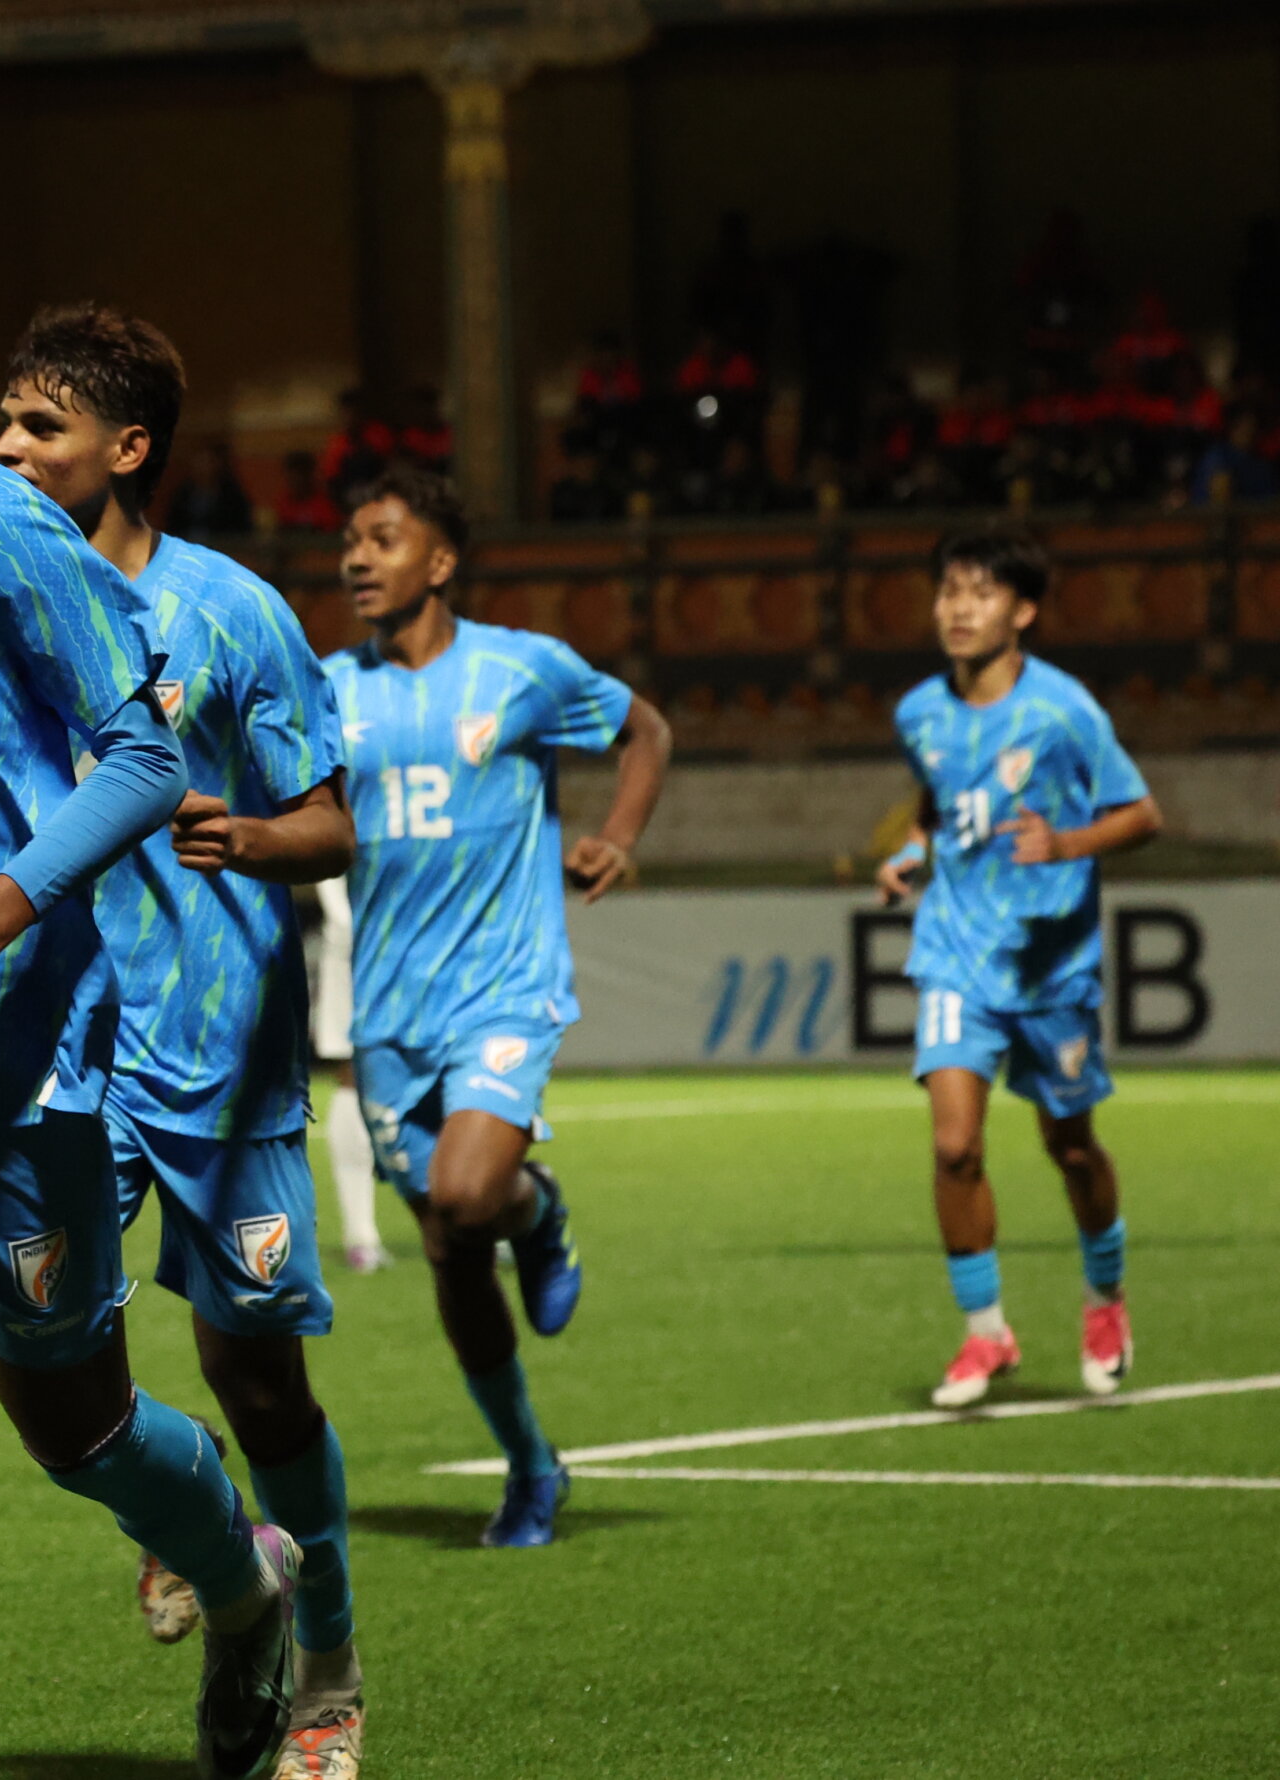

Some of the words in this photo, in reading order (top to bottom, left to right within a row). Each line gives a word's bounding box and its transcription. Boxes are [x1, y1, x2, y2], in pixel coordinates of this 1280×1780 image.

[381, 764, 453, 840] 12
[924, 989, 963, 1048] 11
[22, 1243, 51, 1259] INDIA
